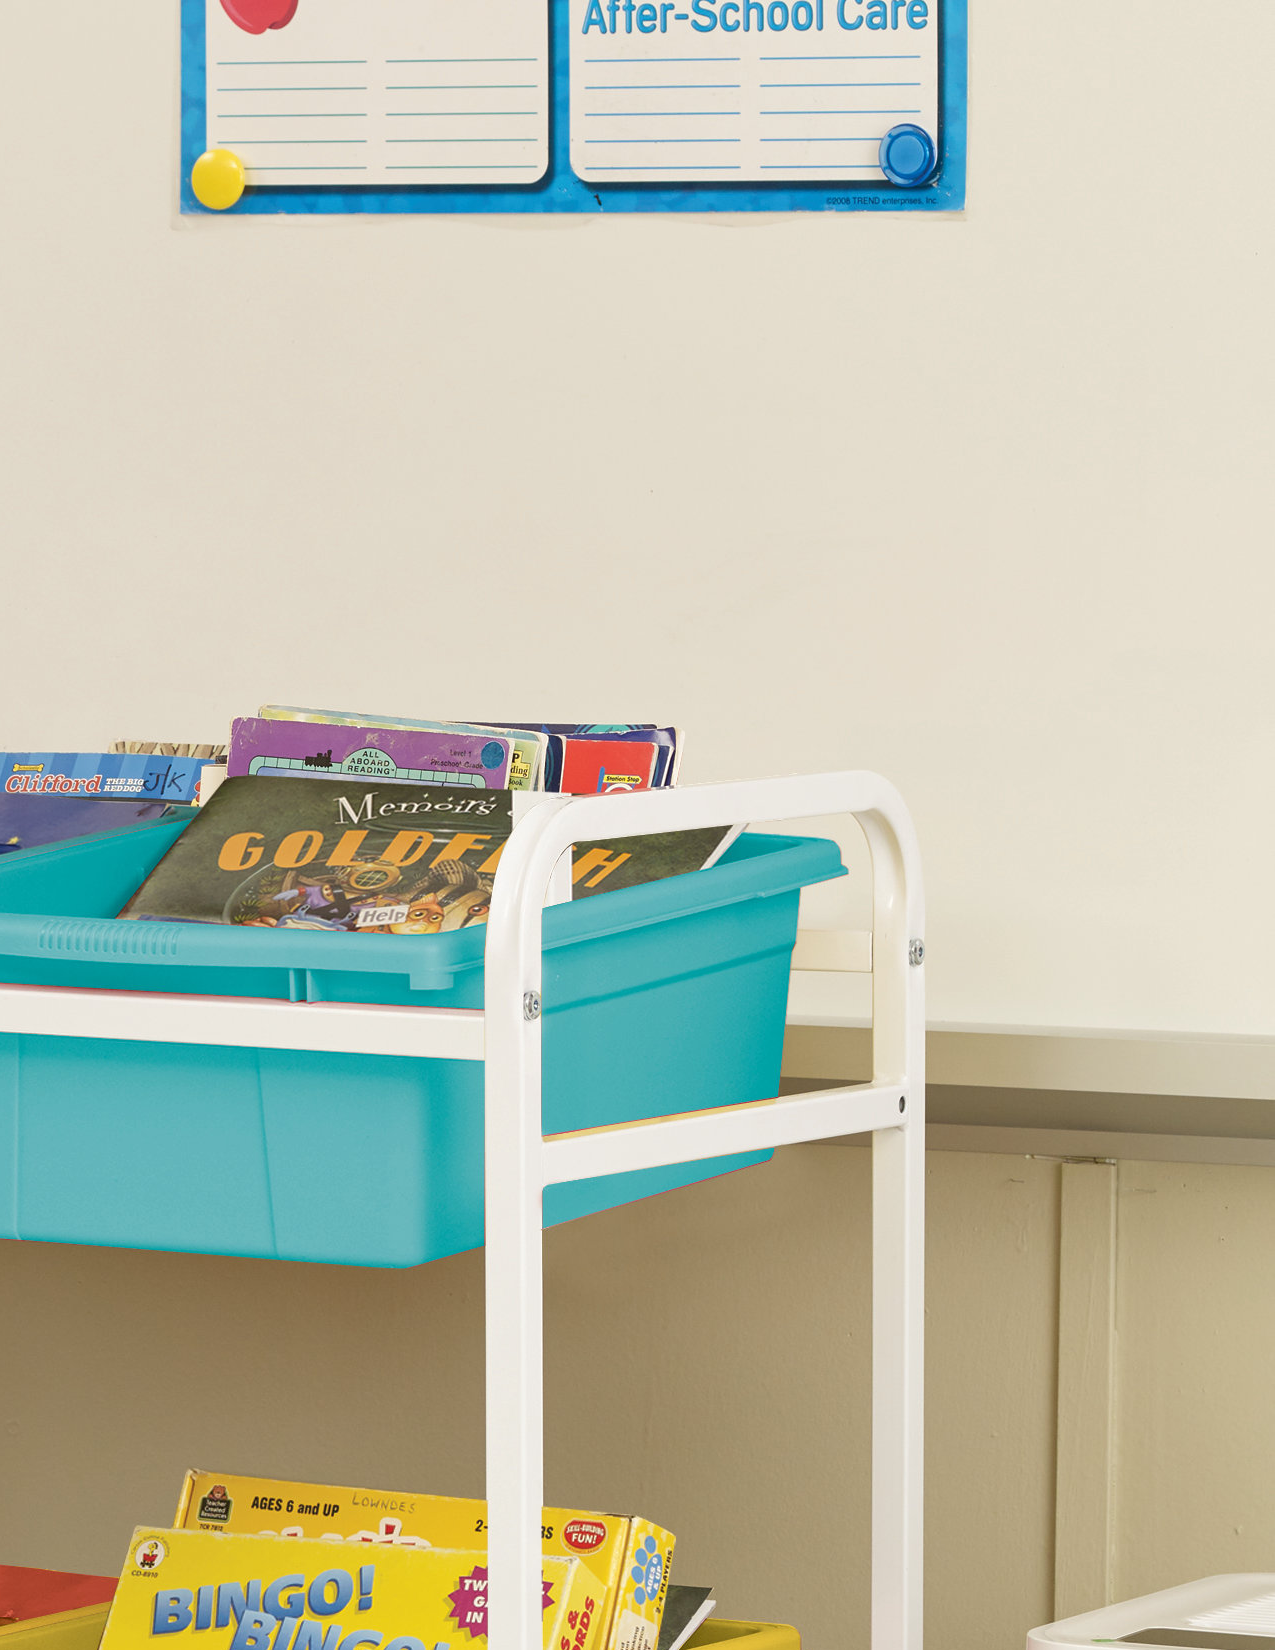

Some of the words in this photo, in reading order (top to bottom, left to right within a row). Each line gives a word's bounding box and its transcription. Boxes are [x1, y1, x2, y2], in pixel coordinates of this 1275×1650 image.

[581, 0, 824, 34] After-School
[836, 0, 929, 31] Care
[350, 757, 390, 767] ABOARD
[362, 750, 380, 758] ALL
[450, 749, 466, 757] Level
[5, 774, 103, 793] Clifford
[128, 778, 145, 786] BIG
[333, 792, 497, 825] Memoirs
[361, 905, 407, 923] Help
[200, 1511, 227, 1519] Resources
[251, 1496, 282, 1511] AGES
[286, 1499, 294, 1512] 6
[297, 1501, 319, 1516] and
[322, 1503, 339, 1518] UP
[572, 1533, 597, 1544] FUN!
[646, 1567, 656, 1594] AGES
[660, 1550, 673, 1593] PLAYERS
[152, 1564, 375, 1635] BINGO!
[465, 1611, 484, 1623] IN
[567, 1610, 580, 1630] &
